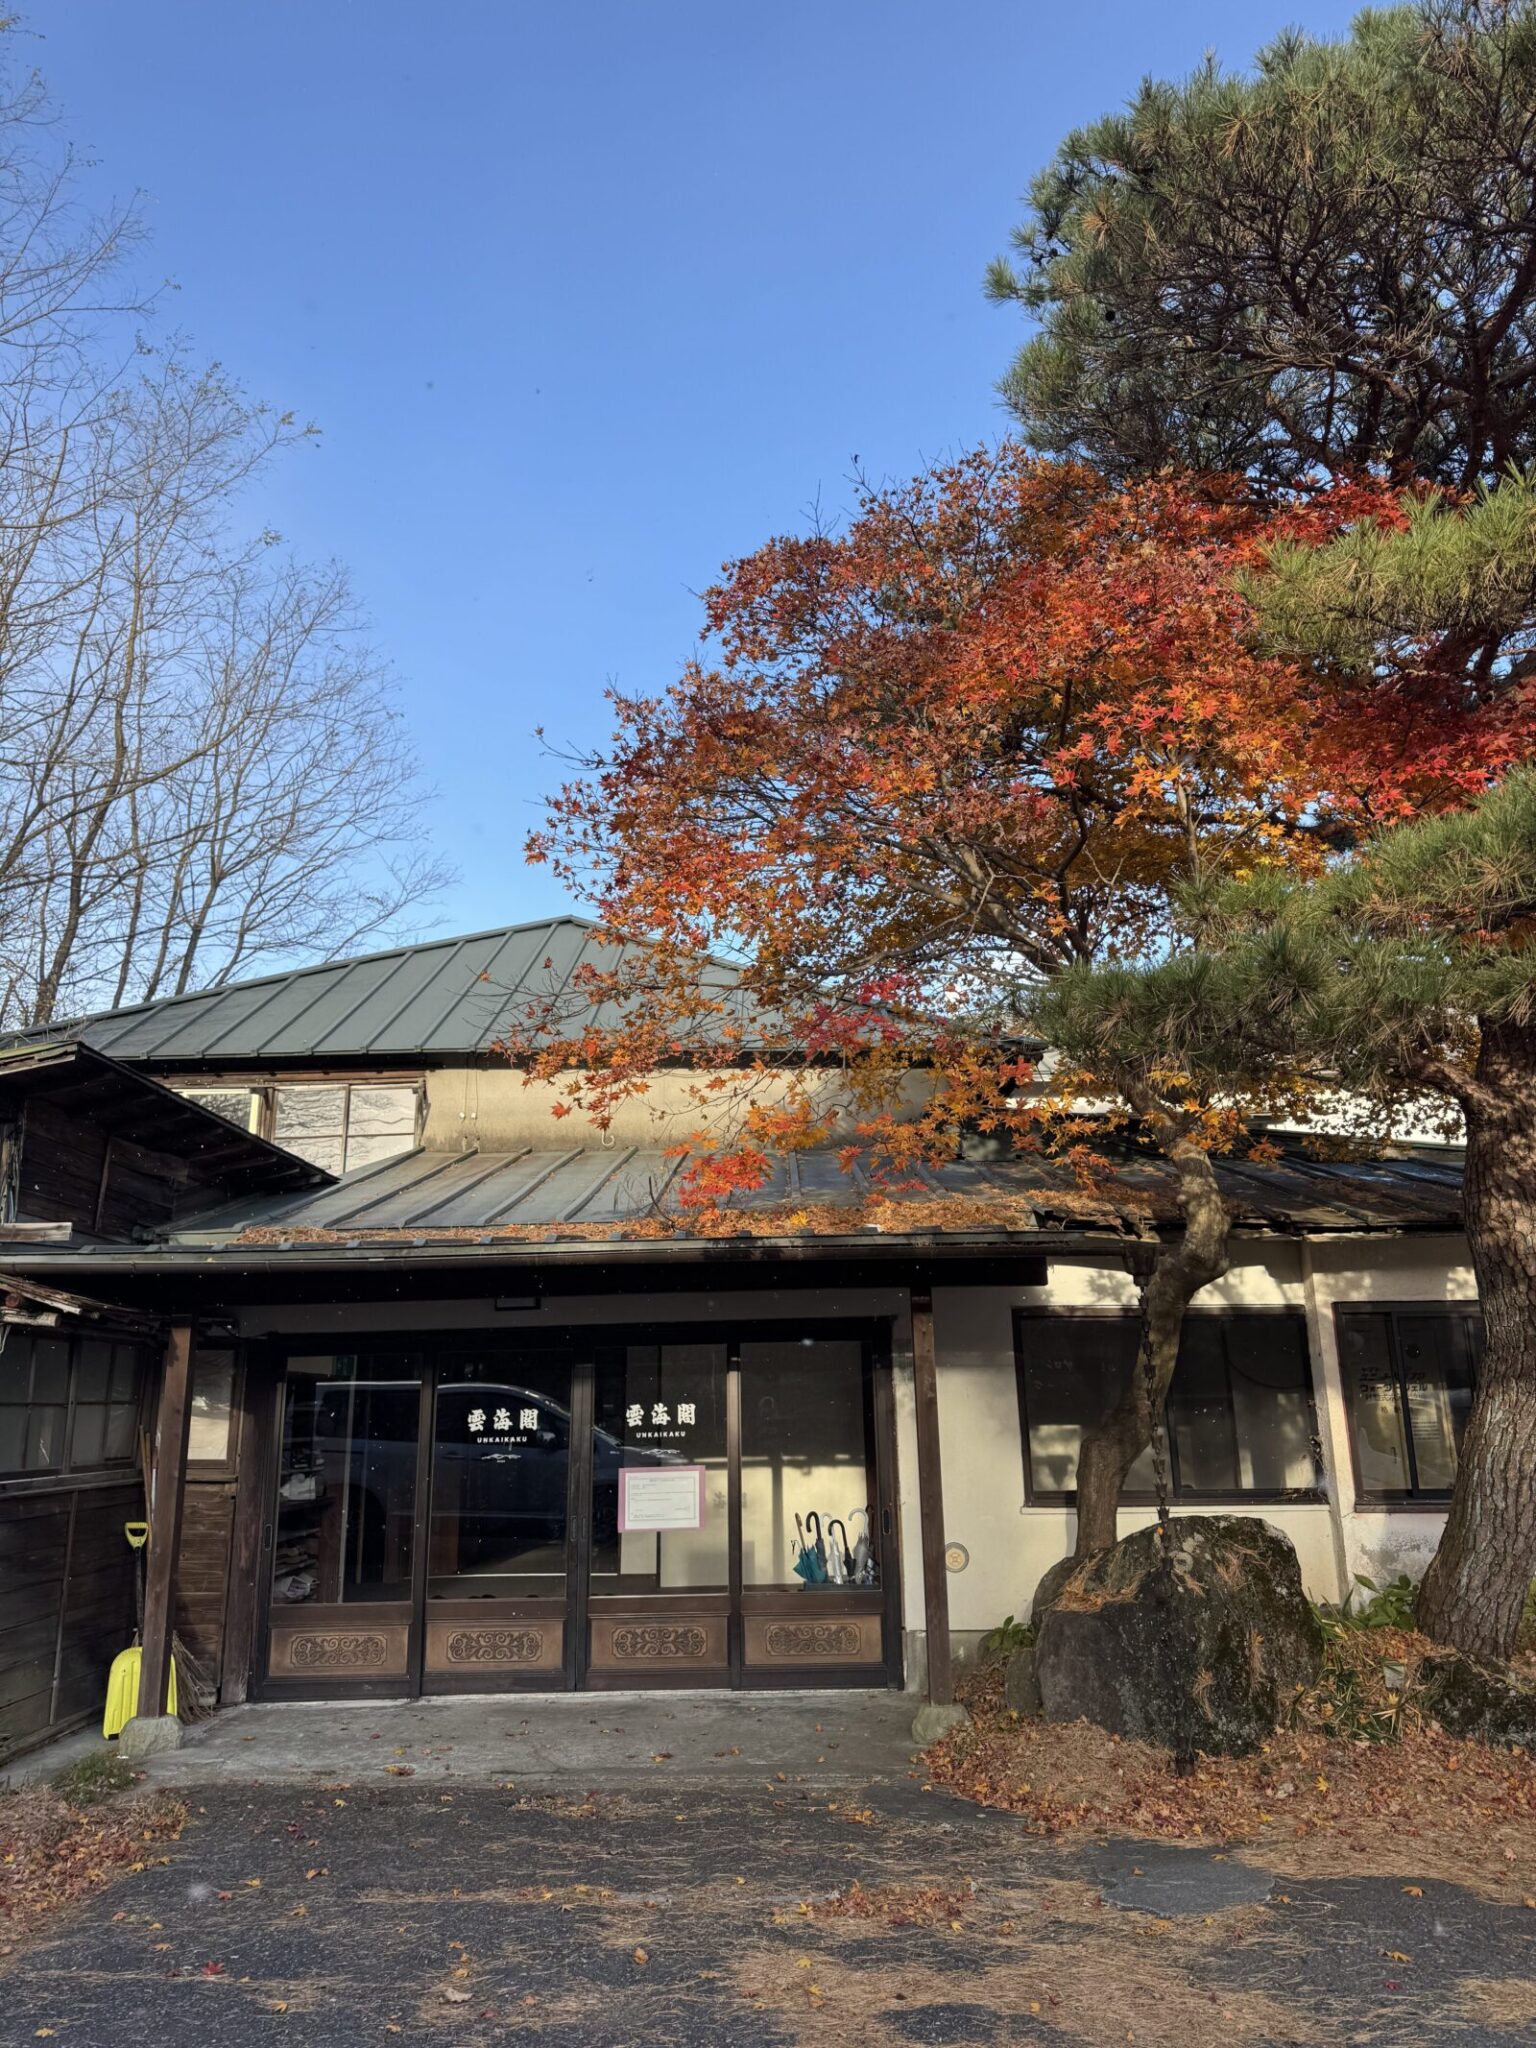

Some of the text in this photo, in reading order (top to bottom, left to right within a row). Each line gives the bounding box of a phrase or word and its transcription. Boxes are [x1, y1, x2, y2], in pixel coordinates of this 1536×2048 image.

[467, 1407, 539, 1432] 雲海閣
[625, 1402, 697, 1427] 雲海閣
[636, 1431, 686, 1439] UNKAIKAKU
